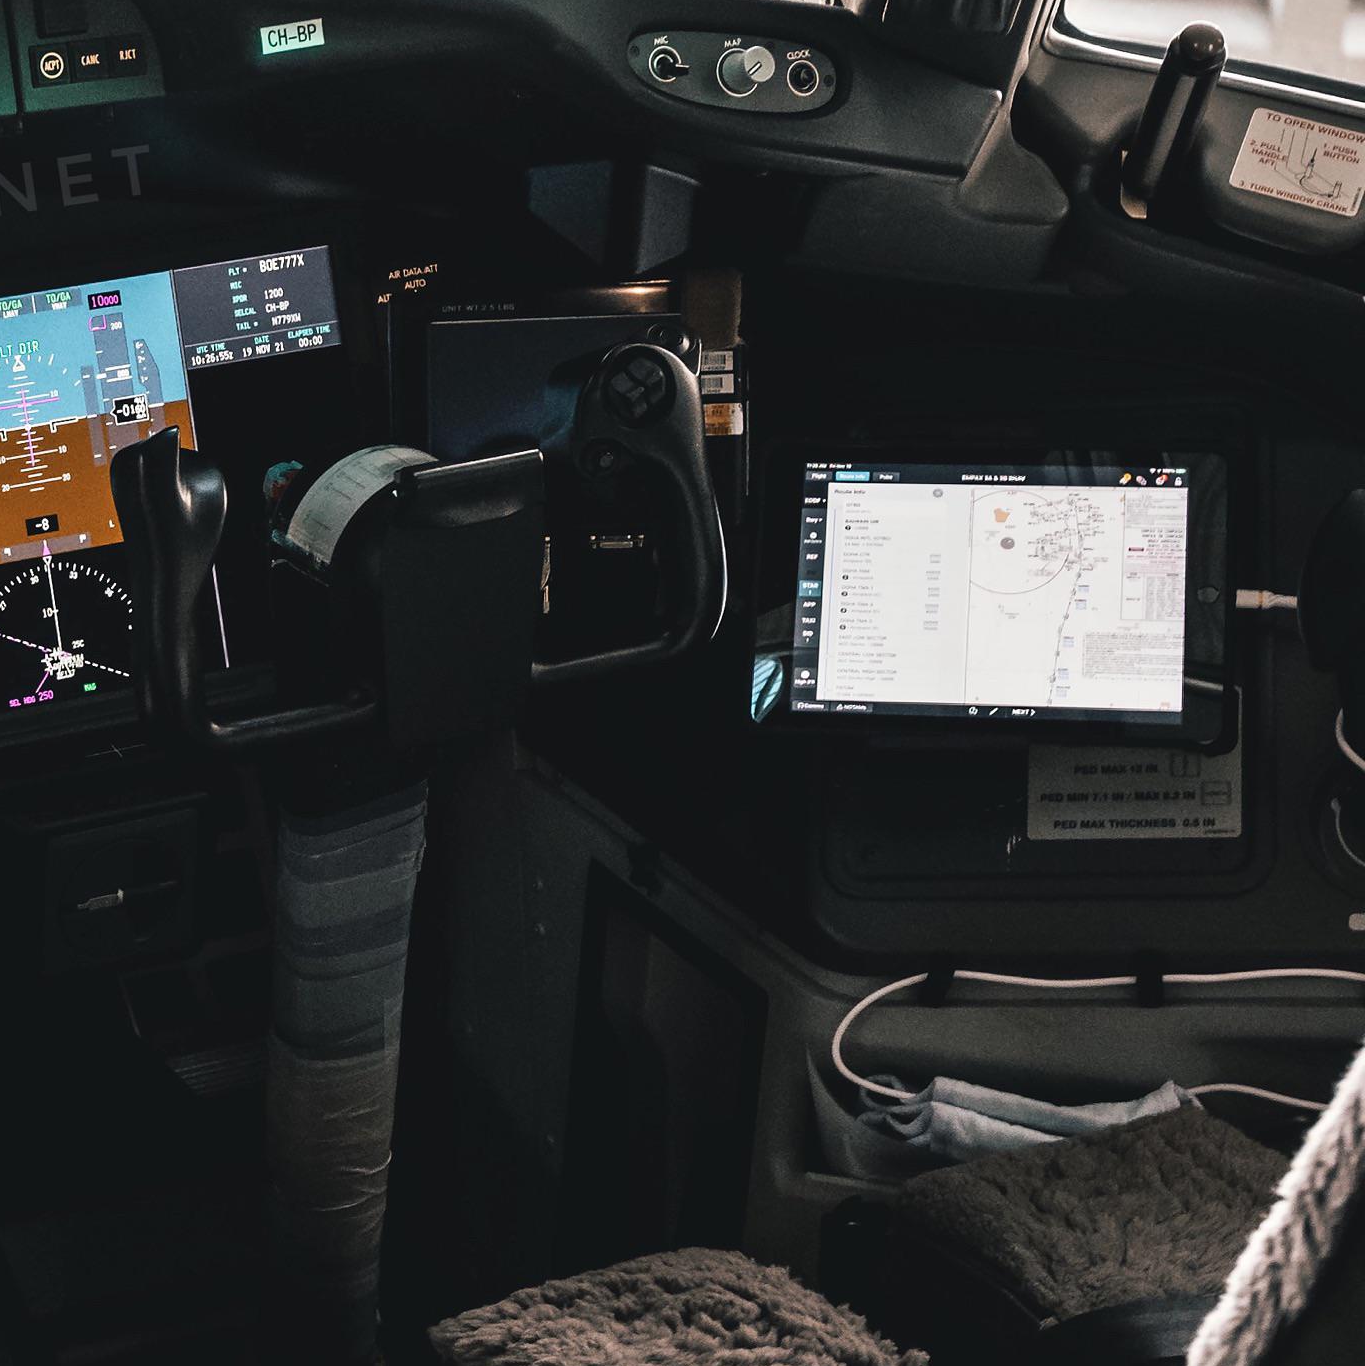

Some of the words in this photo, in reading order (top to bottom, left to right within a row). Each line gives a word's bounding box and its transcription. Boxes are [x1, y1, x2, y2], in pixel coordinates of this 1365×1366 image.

[268, 24, 316, 47] CH-BP
[654, 35, 668, 45] MIC
[786, 49, 811, 60] CLOCK
[1267, 113, 1281, 122] TO
[1284, 116, 1315, 130] OPEN
[1318, 126, 1365, 144] WINDOW
[1260, 142, 1282, 152] PULL
[1333, 145, 1357, 155] PUSH
[1323, 151, 1360, 164] BUTTON
[1276, 189, 1315, 204] WINDOW
[259, 254, 305, 274] BOE777X
[263, 287, 284, 300] 1200
[298, 334, 324, 348] 00:00
[242, 346, 253, 357] 19
[255, 343, 272, 355] NOV
[274, 342, 285, 353] 21
